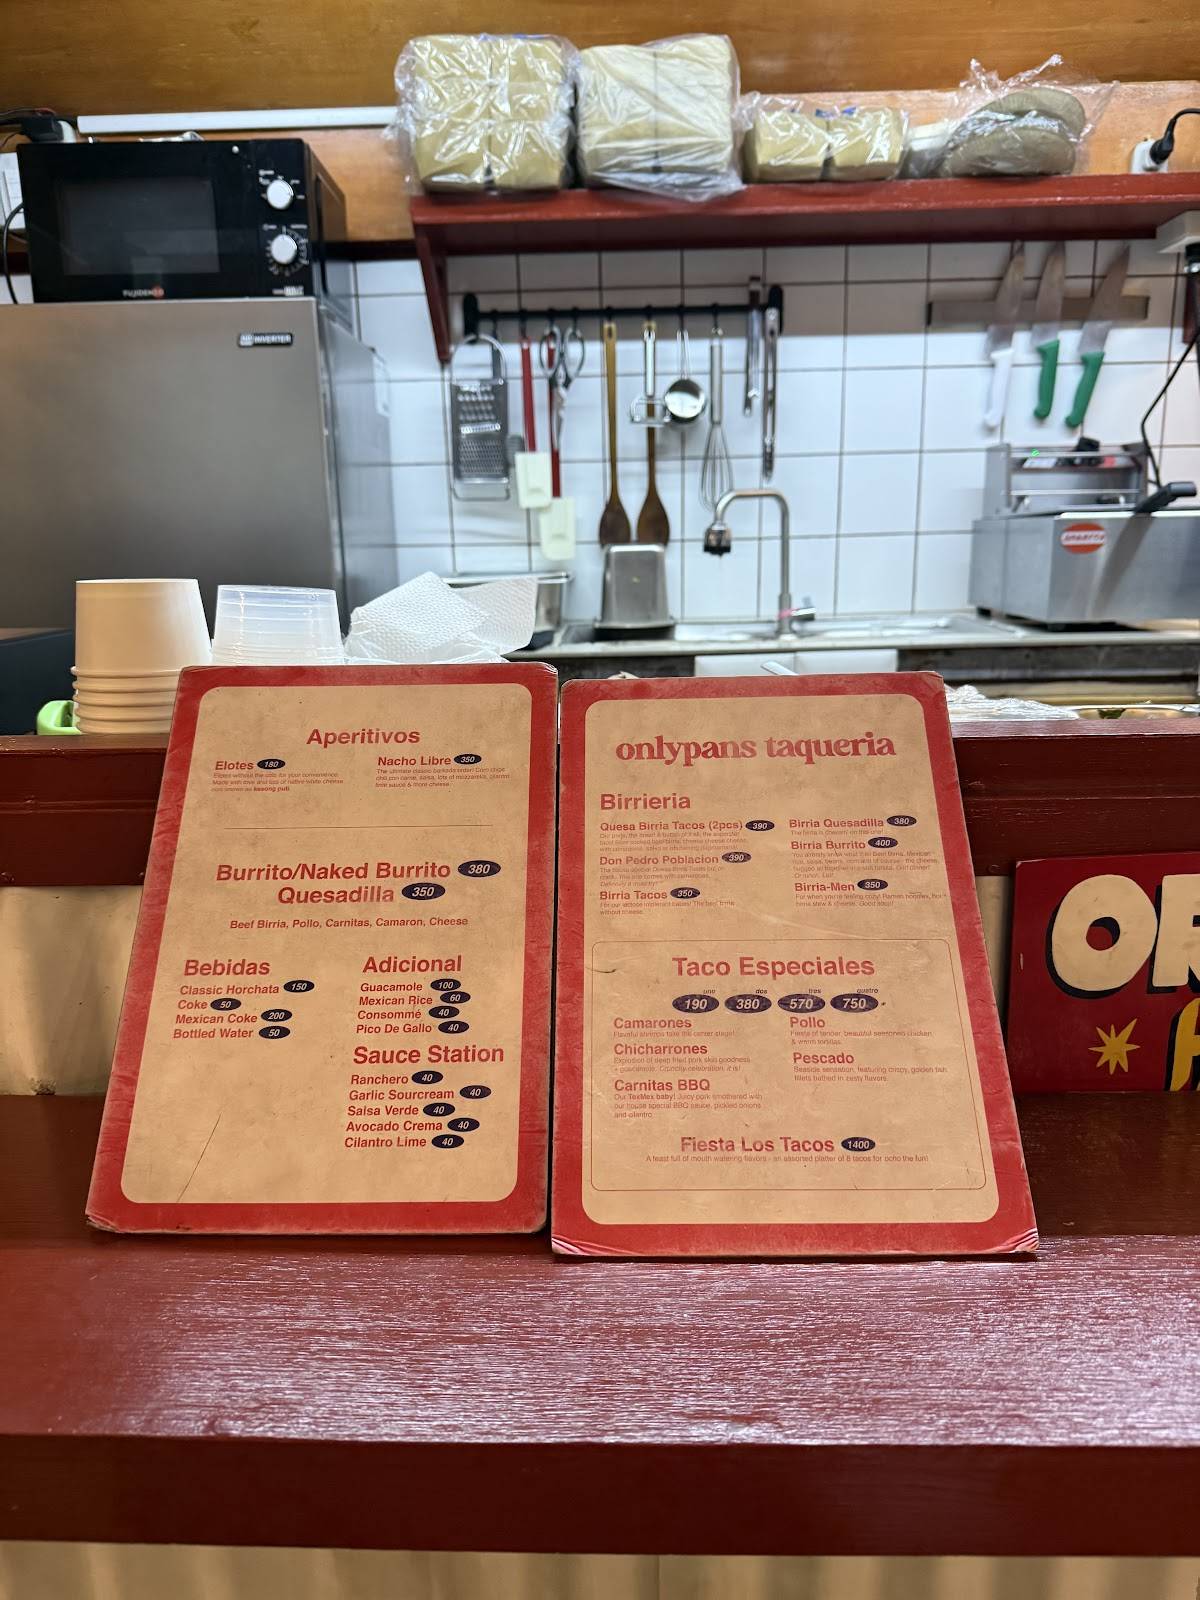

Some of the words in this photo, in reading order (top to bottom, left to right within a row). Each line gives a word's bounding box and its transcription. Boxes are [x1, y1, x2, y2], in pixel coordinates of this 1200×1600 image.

[307, 728, 421, 748] Aperitivos
[615, 735, 757, 767] onlypans
[766, 732, 897, 764] taqueria
[215, 760, 254, 771] Elotes
[378, 756, 416, 766] Nacho
[420, 756, 452, 766] Libre
[600, 792, 691, 810] Birrieria
[600, 822, 636, 831] Quesa
[639, 821, 669, 831] Birria
[672, 821, 705, 830] Tacos
[708, 820, 743, 832] (2pcs)
[752, 822, 768, 830] 390
[789, 819, 820, 828] Birria
[823, 818, 884, 828] Quesadilla
[893, 817, 909, 825] 380
[791, 841, 822, 850] Birria
[826, 840, 866, 849] Burrito
[875, 839, 890, 847] 400
[599, 856, 622, 865] Don
[625, 855, 659, 865] Pedro
[662, 854, 719, 864] Poblacion
[728, 854, 744, 862] 390
[216, 863, 369, 881] Burrito/Naked
[376, 861, 451, 879] Burrito
[468, 864, 491, 875] 380
[795, 882, 855, 892] Birria-Men
[864, 881, 880, 889] 350
[278, 885, 395, 904] Quesadilla
[411, 886, 435, 897] 350
[600, 891, 631, 900] Birria
[634, 890, 668, 900] Tacos
[677, 889, 693, 897] 350
[230, 919, 255, 929] Beef
[257, 919, 289, 930] Birria,
[292, 918, 323, 930] Pollo,
[325, 918, 373, 929] Carnitas,
[376, 917, 426, 928] Camaron,
[429, 917, 468, 926] Cheese
[184, 959, 271, 976] Bebidas
[362, 955, 462, 973] Adicional
[672, 957, 731, 977] Taco
[740, 956, 875, 980] Especiales
[180, 985, 223, 995] Classic
[226, 984, 280, 995] Horchata
[291, 983, 307, 991] 150
[360, 982, 423, 992] Guacamole
[438, 981, 454, 989] 100
[178, 1000, 208, 1010] Coke
[359, 996, 405, 1006] Mexican
[408, 995, 433, 1005] Rice
[449, 994, 461, 1002] 60
[684, 999, 708, 1010] 190
[736, 999, 760, 1009] 380
[789, 998, 814, 1009] 570
[843, 998, 867, 1009] 750
[175, 1014, 224, 1024] Mexican
[227, 1013, 258, 1023] Coke
[268, 1012, 285, 1020] 200
[357, 1009, 422, 1020] Consommé
[614, 1017, 692, 1029] Camarones
[790, 1016, 826, 1028] Pollo
[173, 1028, 216, 1039] Bottled
[219, 1028, 254, 1038] Water
[356, 1024, 381, 1034] Pico
[384, 1024, 400, 1033] De
[403, 1023, 432, 1033] Gallo
[353, 1046, 421, 1064] Sauce
[427, 1045, 504, 1063] Station
[614, 1043, 708, 1055] Chicharrones
[793, 1052, 855, 1064] Pescado
[350, 1074, 409, 1085] Ranchero
[421, 1074, 433, 1082] 40
[614, 1079, 673, 1091] Carnitas
[677, 1079, 710, 1091] BBQ
[349, 1090, 385, 1101] Garlic
[388, 1089, 454, 1100] Sourcream
[469, 1088, 481, 1097] 40
[656, 1093, 676, 1102] baby!
[347, 1105, 381, 1116] Salsa
[385, 1105, 419, 1115] Verde
[433, 1106, 445, 1114] 40
[345, 1121, 400, 1132] Avocado
[403, 1121, 443, 1131] Crema
[457, 1121, 469, 1129] 40
[344, 1137, 393, 1148] Cilantro
[396, 1137, 427, 1147] Lime
[441, 1138, 454, 1146] 40
[680, 1137, 735, 1152] Fiesta
[741, 1137, 775, 1152] Los
[779, 1136, 835, 1152] Tacos
[847, 1140, 870, 1149] 1400
